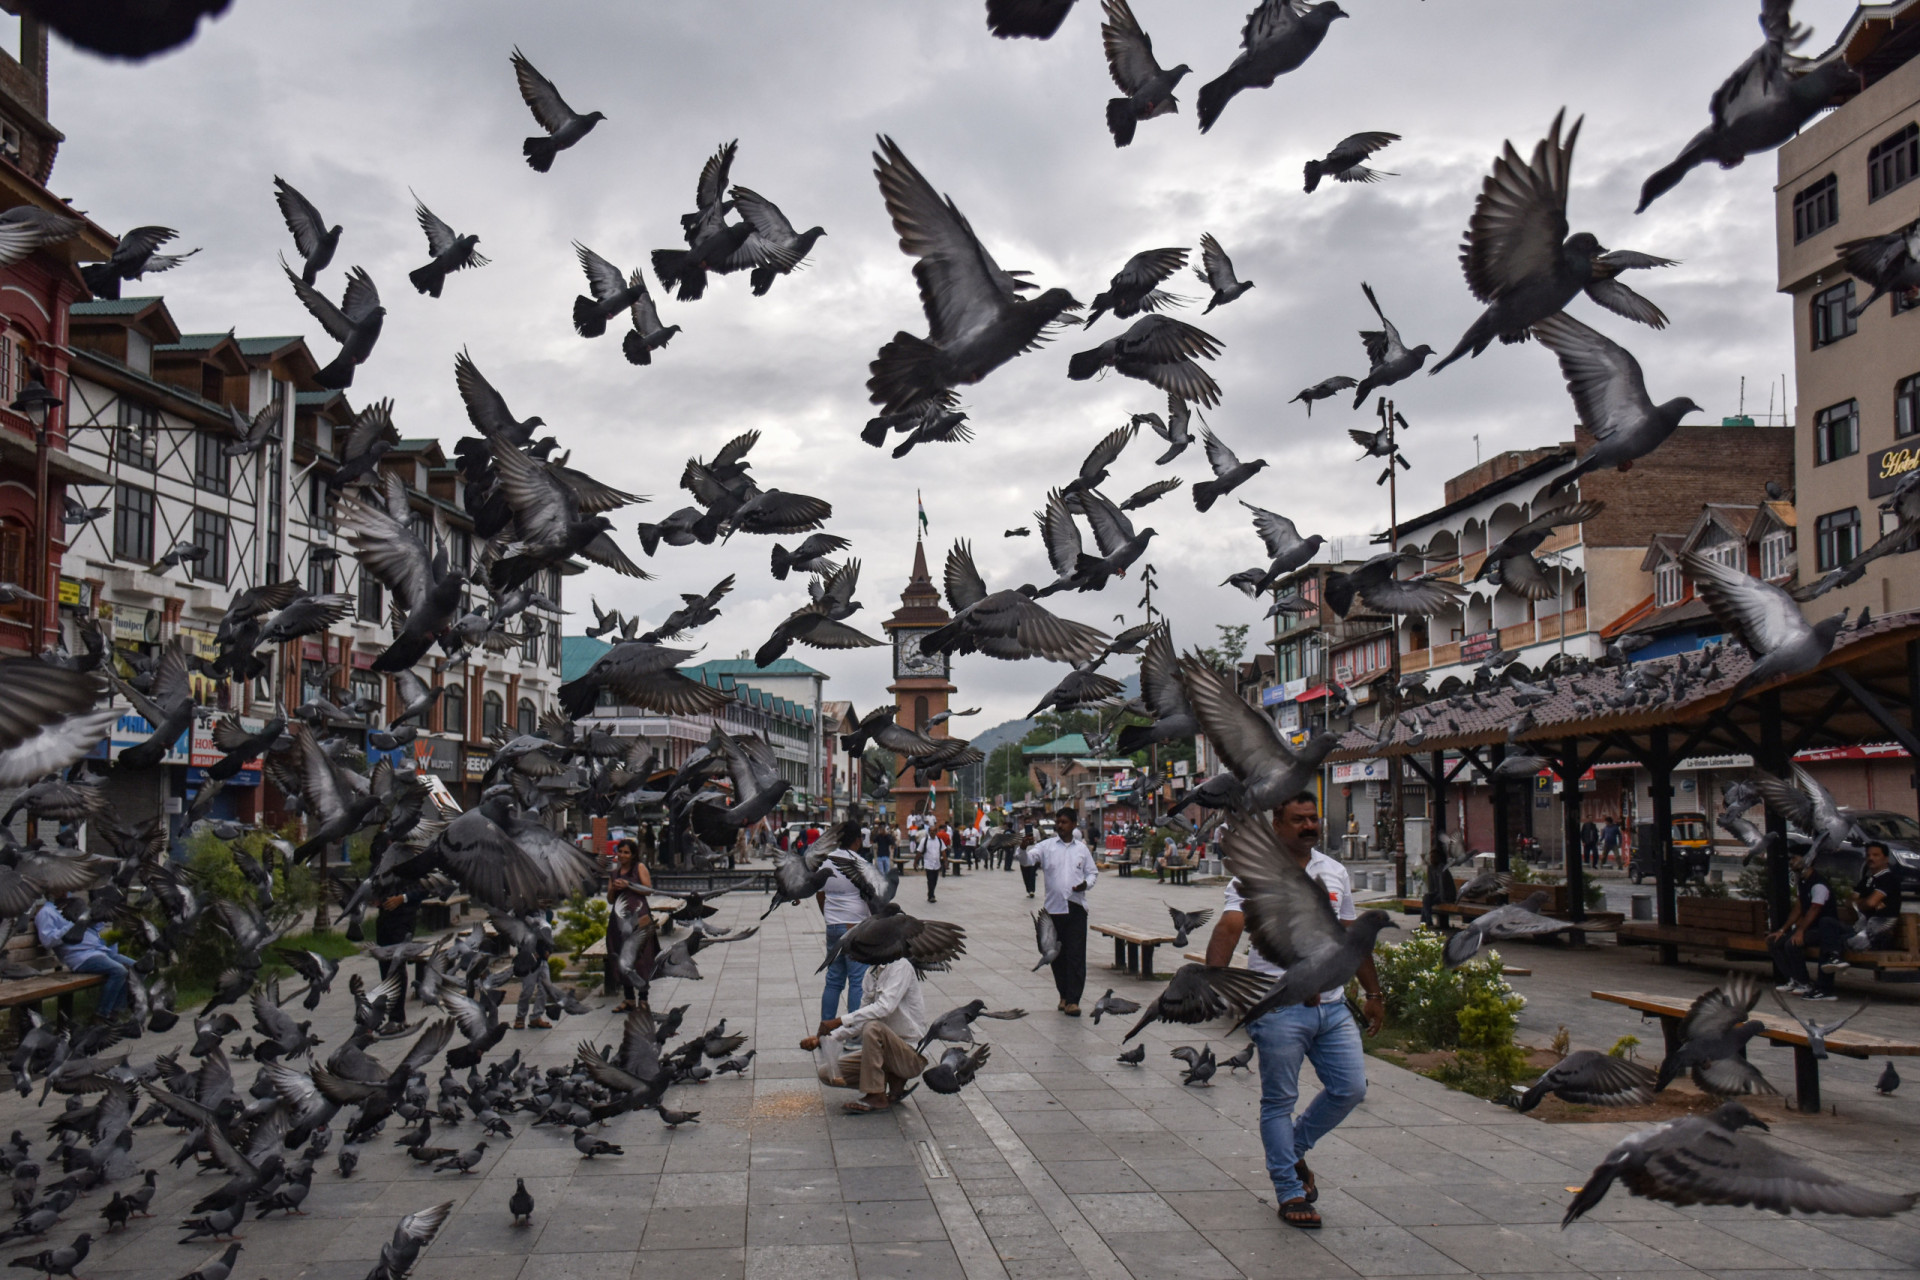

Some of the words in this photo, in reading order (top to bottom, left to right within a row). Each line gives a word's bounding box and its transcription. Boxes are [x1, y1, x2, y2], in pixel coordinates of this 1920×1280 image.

[114, 616, 143, 631] Juniper
[199, 641, 221, 656] Junip
[1539, 777, 1547, 788] P
